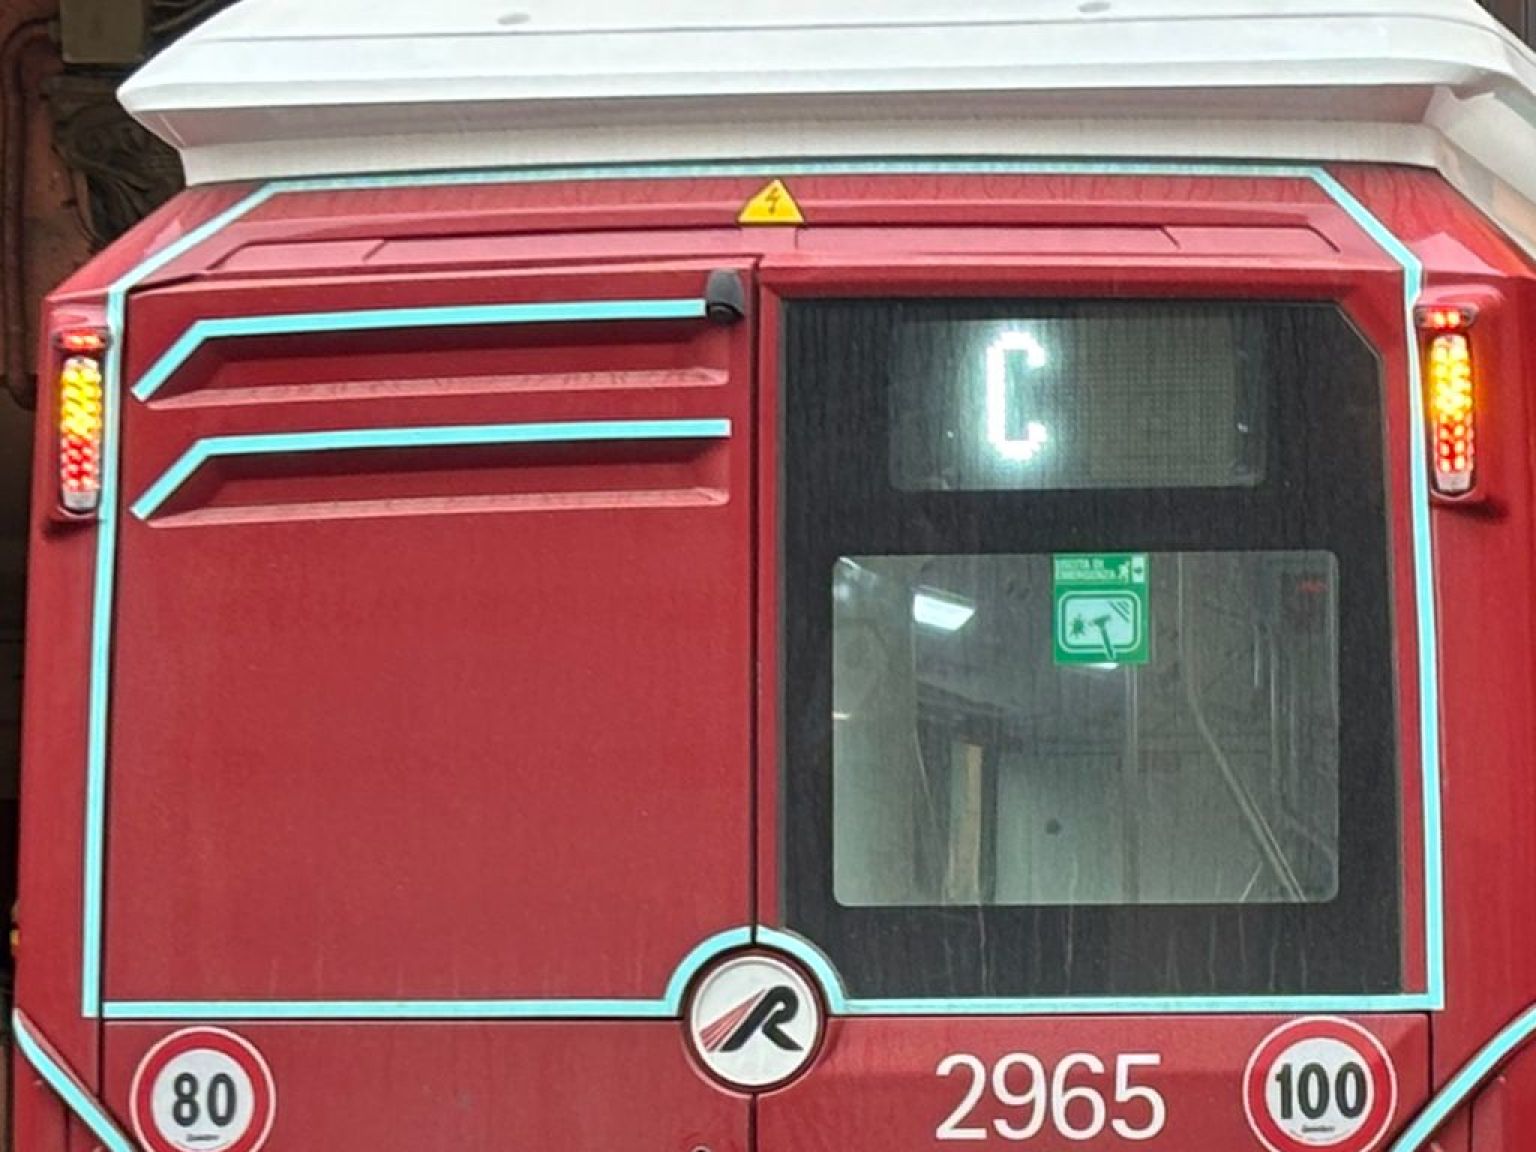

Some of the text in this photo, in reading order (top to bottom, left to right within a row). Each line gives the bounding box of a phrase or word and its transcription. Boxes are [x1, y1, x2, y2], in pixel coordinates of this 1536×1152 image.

[984, 331, 1046, 460] C
[171, 1072, 238, 1128] 80
[935, 1052, 1168, 1141] 2965
[1275, 1061, 1368, 1119] 100
